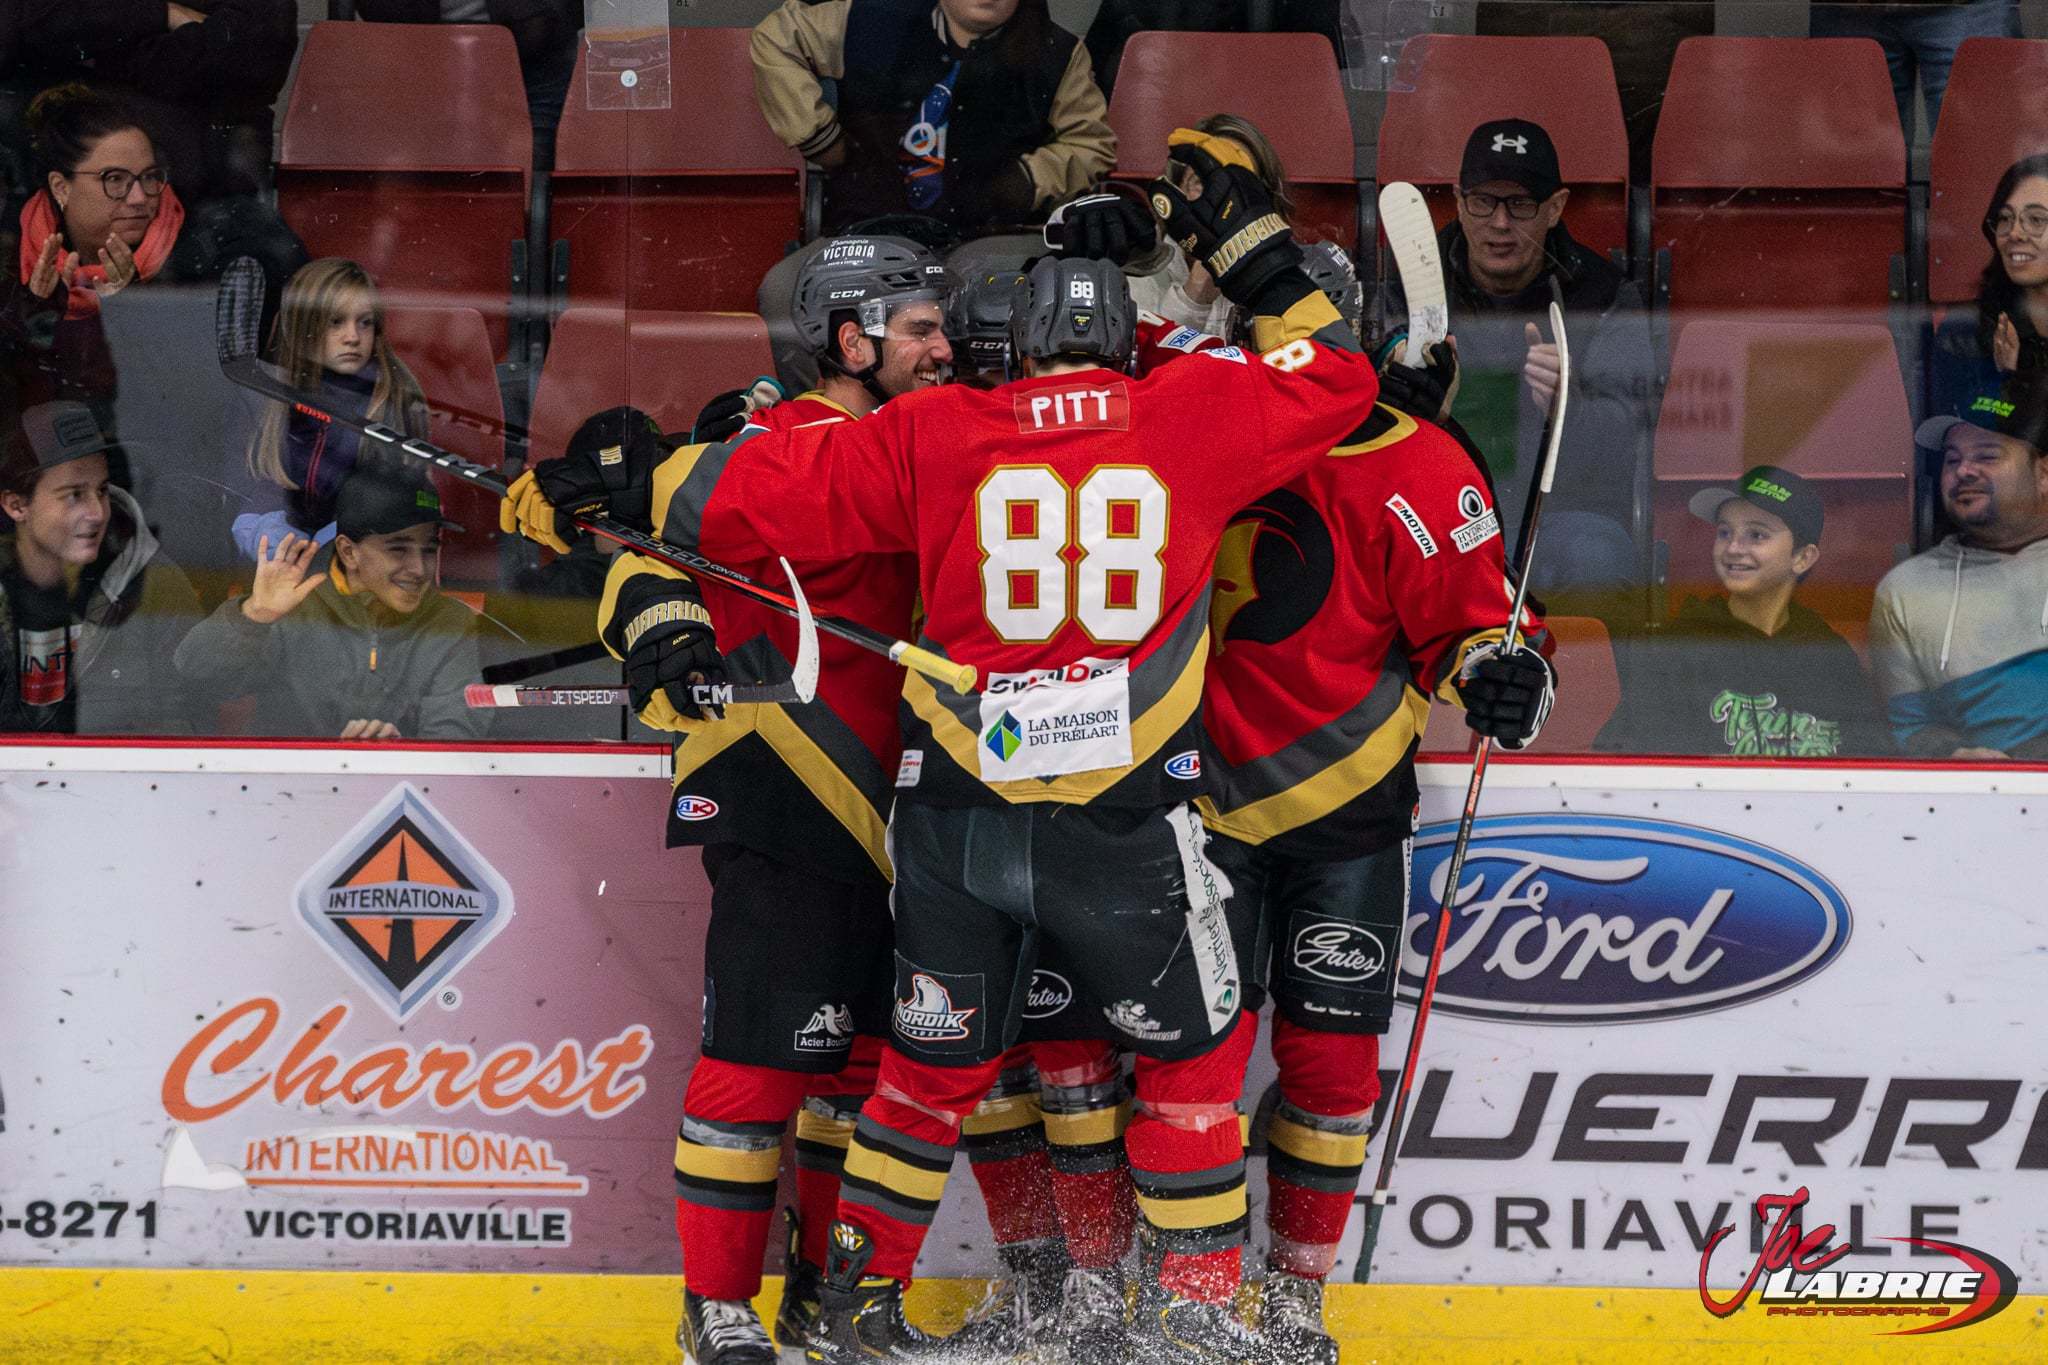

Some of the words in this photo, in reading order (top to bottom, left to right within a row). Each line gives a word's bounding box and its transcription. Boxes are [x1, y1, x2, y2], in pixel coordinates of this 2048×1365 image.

[823, 245, 875, 261] VICTORIA
[830, 289, 867, 299] CCM
[1070, 281, 1095, 299] 88
[1031, 389, 1111, 429] PITT
[364, 422, 496, 478] CCM
[1400, 508, 1435, 554] MOTION
[974, 463, 1171, 645] 88
[710, 564, 752, 584] CONTROL
[552, 690, 612, 705] JETSPEED
[688, 684, 734, 705] CM
[1028, 718, 1050, 732] LA
[1054, 709, 1119, 729] MAISON
[1029, 733, 1050, 747] DU
[1052, 724, 1119, 744] PRÉLART
[328, 887, 480, 909] INTERNATIONAL
[1402, 848, 1734, 985] Ford
[1207, 918, 1228, 984] Verrier
[1294, 931, 1377, 970] Gates
[1026, 976, 1064, 1007] ates
[161, 998, 648, 1124] Charest
[1366, 1069, 2048, 1170] UERR
[0, 1200, 157, 1238] -8271
[244, 1210, 567, 1241] VICTORIAVILLE
